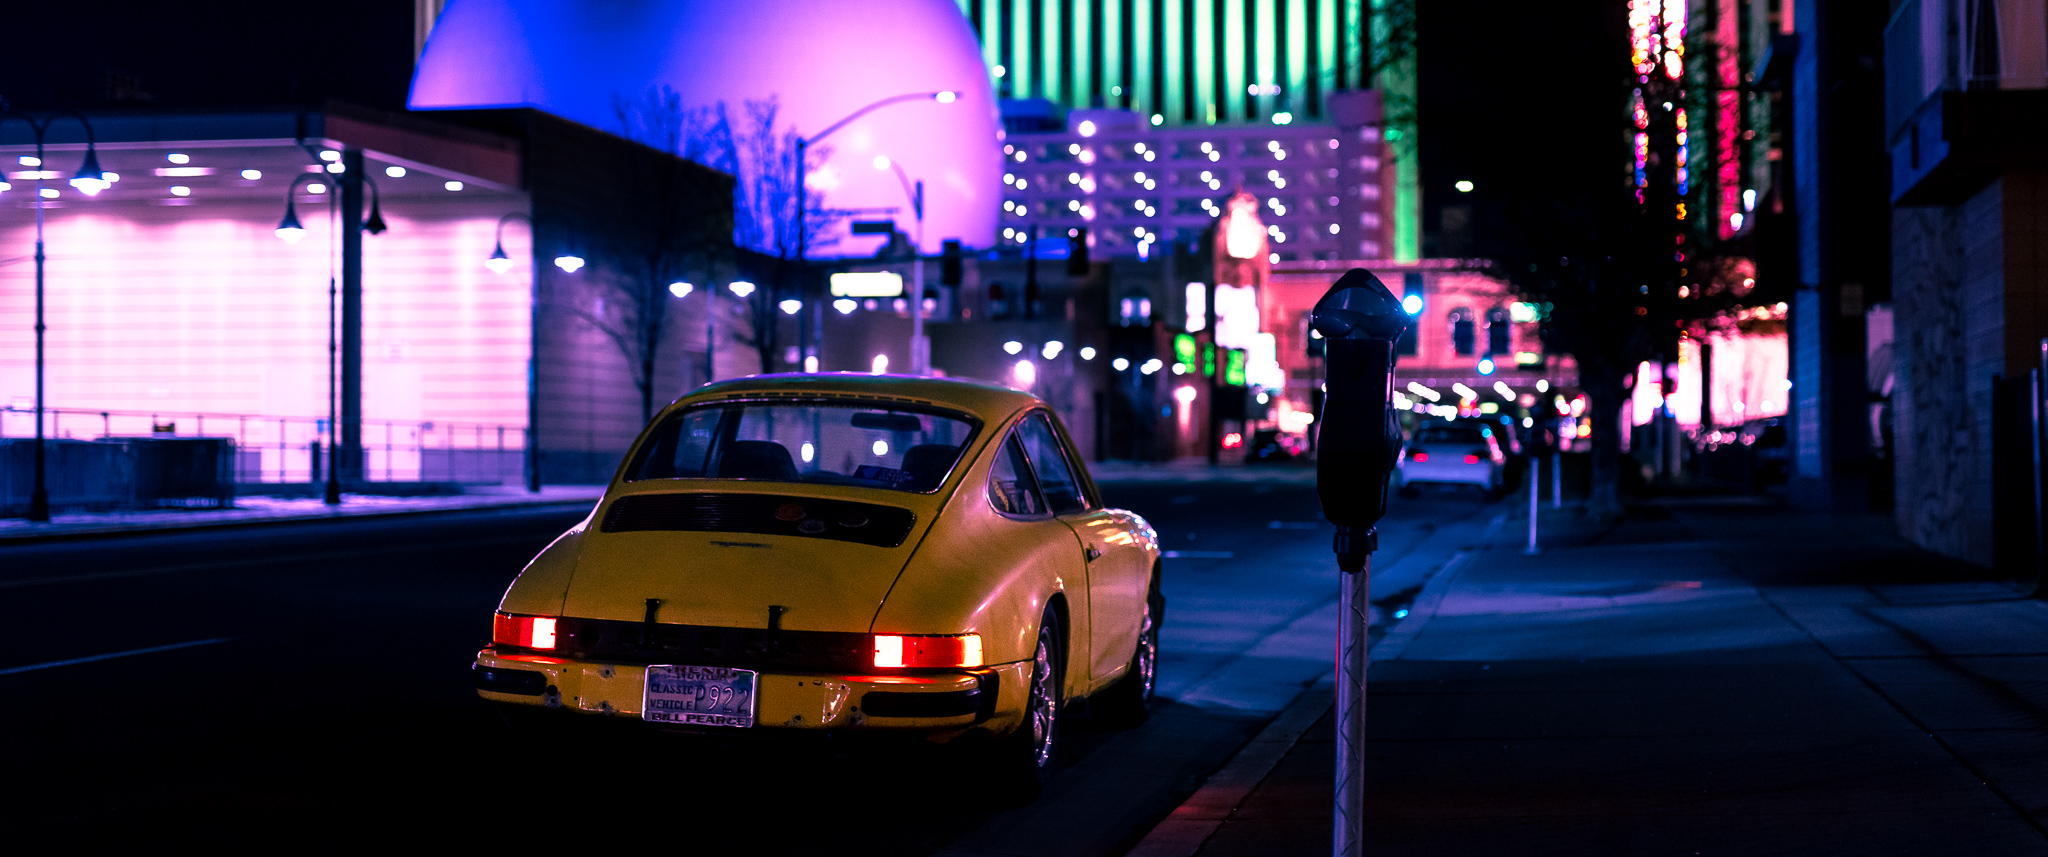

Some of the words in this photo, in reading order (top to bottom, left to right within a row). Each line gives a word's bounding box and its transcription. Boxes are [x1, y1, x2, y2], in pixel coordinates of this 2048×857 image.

[675, 666, 728, 676] RENO
[650, 699, 693, 710] VEHICLE
[651, 683, 694, 695] CLASSIC
[695, 684, 749, 714] P922
[652, 712, 683, 722] BILL
[686, 714, 746, 726] PEARCE
